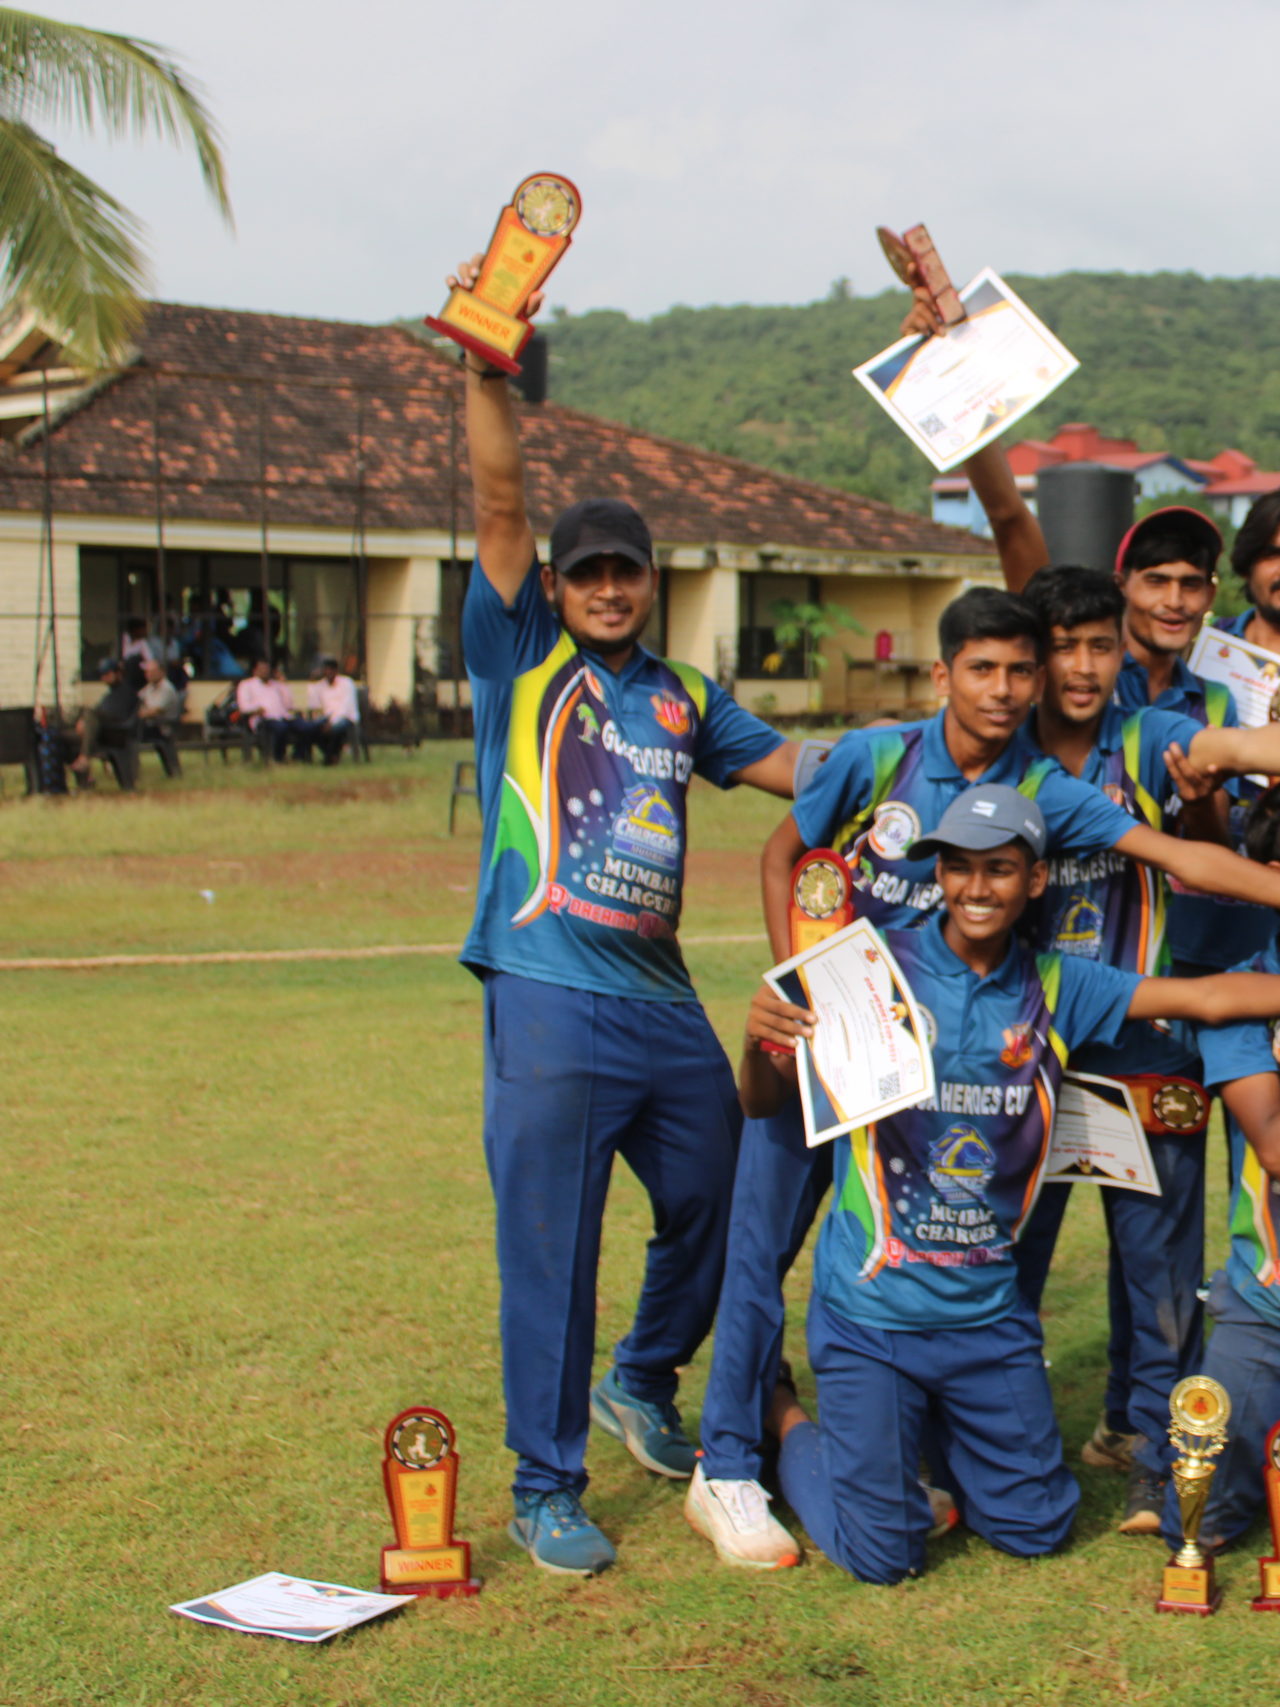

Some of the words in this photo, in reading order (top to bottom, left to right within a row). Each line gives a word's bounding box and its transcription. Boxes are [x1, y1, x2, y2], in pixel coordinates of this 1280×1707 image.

[458, 304, 511, 340] WINNER
[603, 855, 676, 895] MUMBAI
[871, 871, 909, 904] GOA
[941, 1081, 1002, 1116] HEROES
[398, 1558, 454, 1574] WINNER
